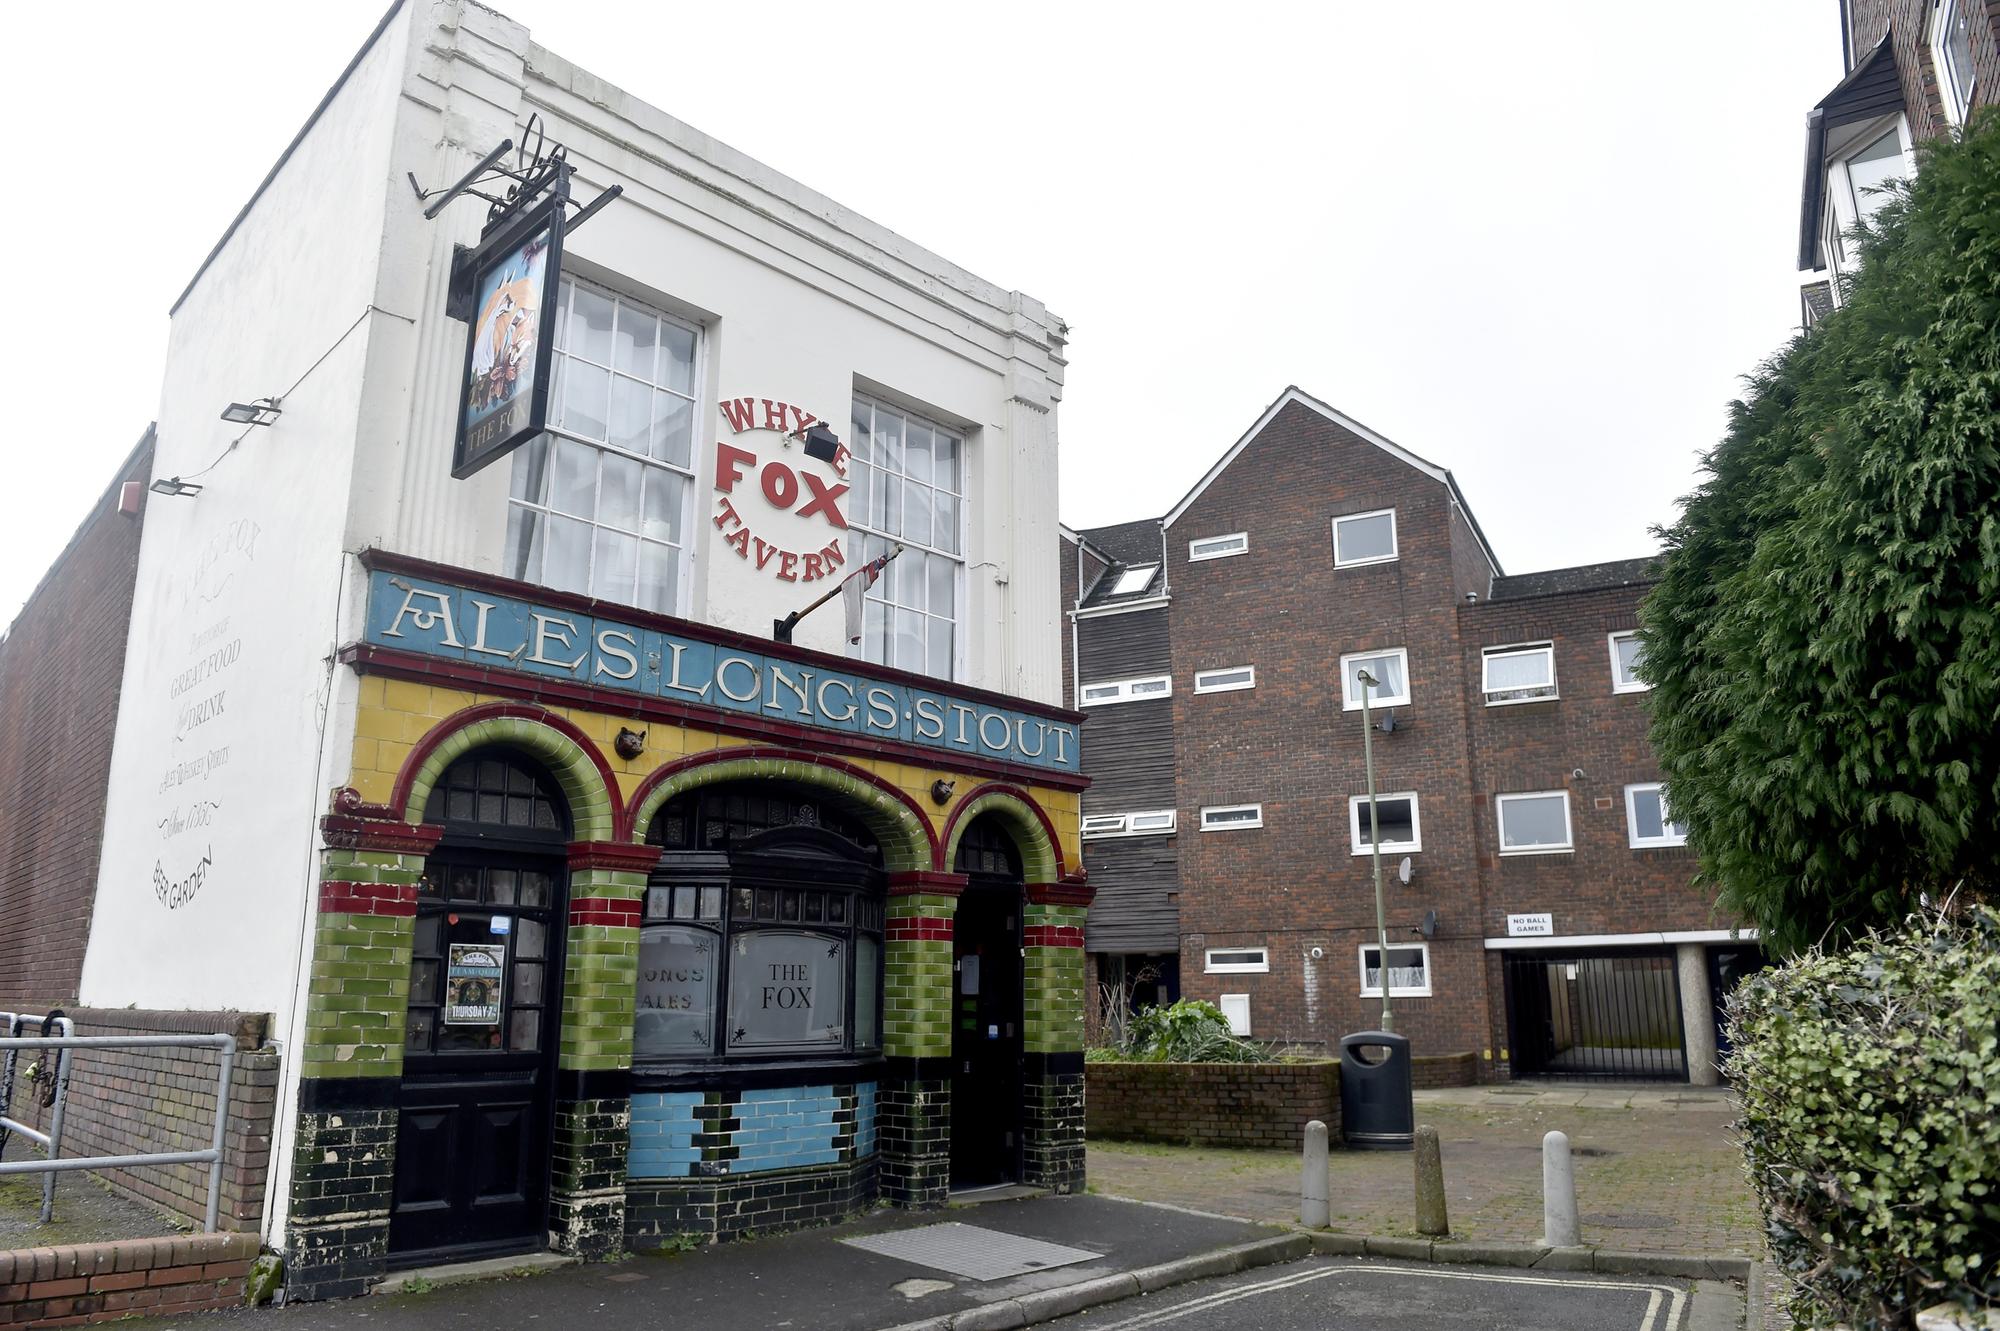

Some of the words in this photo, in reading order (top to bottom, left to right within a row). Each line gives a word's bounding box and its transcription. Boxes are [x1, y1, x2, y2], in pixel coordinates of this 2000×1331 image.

[469, 419, 495, 451] THE
[498, 403, 526, 433] FOX
[718, 397, 852, 479] WHYE
[714, 441, 851, 530] FOX
[223, 517, 262, 563] FOX
[712, 496, 846, 583] TAVERN
[170, 658, 207, 700] GREAT
[207, 638, 241, 678] FOOD
[381, 577, 638, 680] ALES
[665, 642, 898, 730] LONGS
[915, 697, 1075, 764] STOUT
[187, 689, 226, 732] DRINK
[153, 858, 169, 907] BEER
[169, 842, 213, 911] GARDEN
[637, 967, 705, 983] ONGS
[768, 963, 809, 982] THE
[452, 1005, 487, 1018] THURSDAY
[640, 993, 692, 1010] ALES
[761, 985, 813, 1010] FOX
